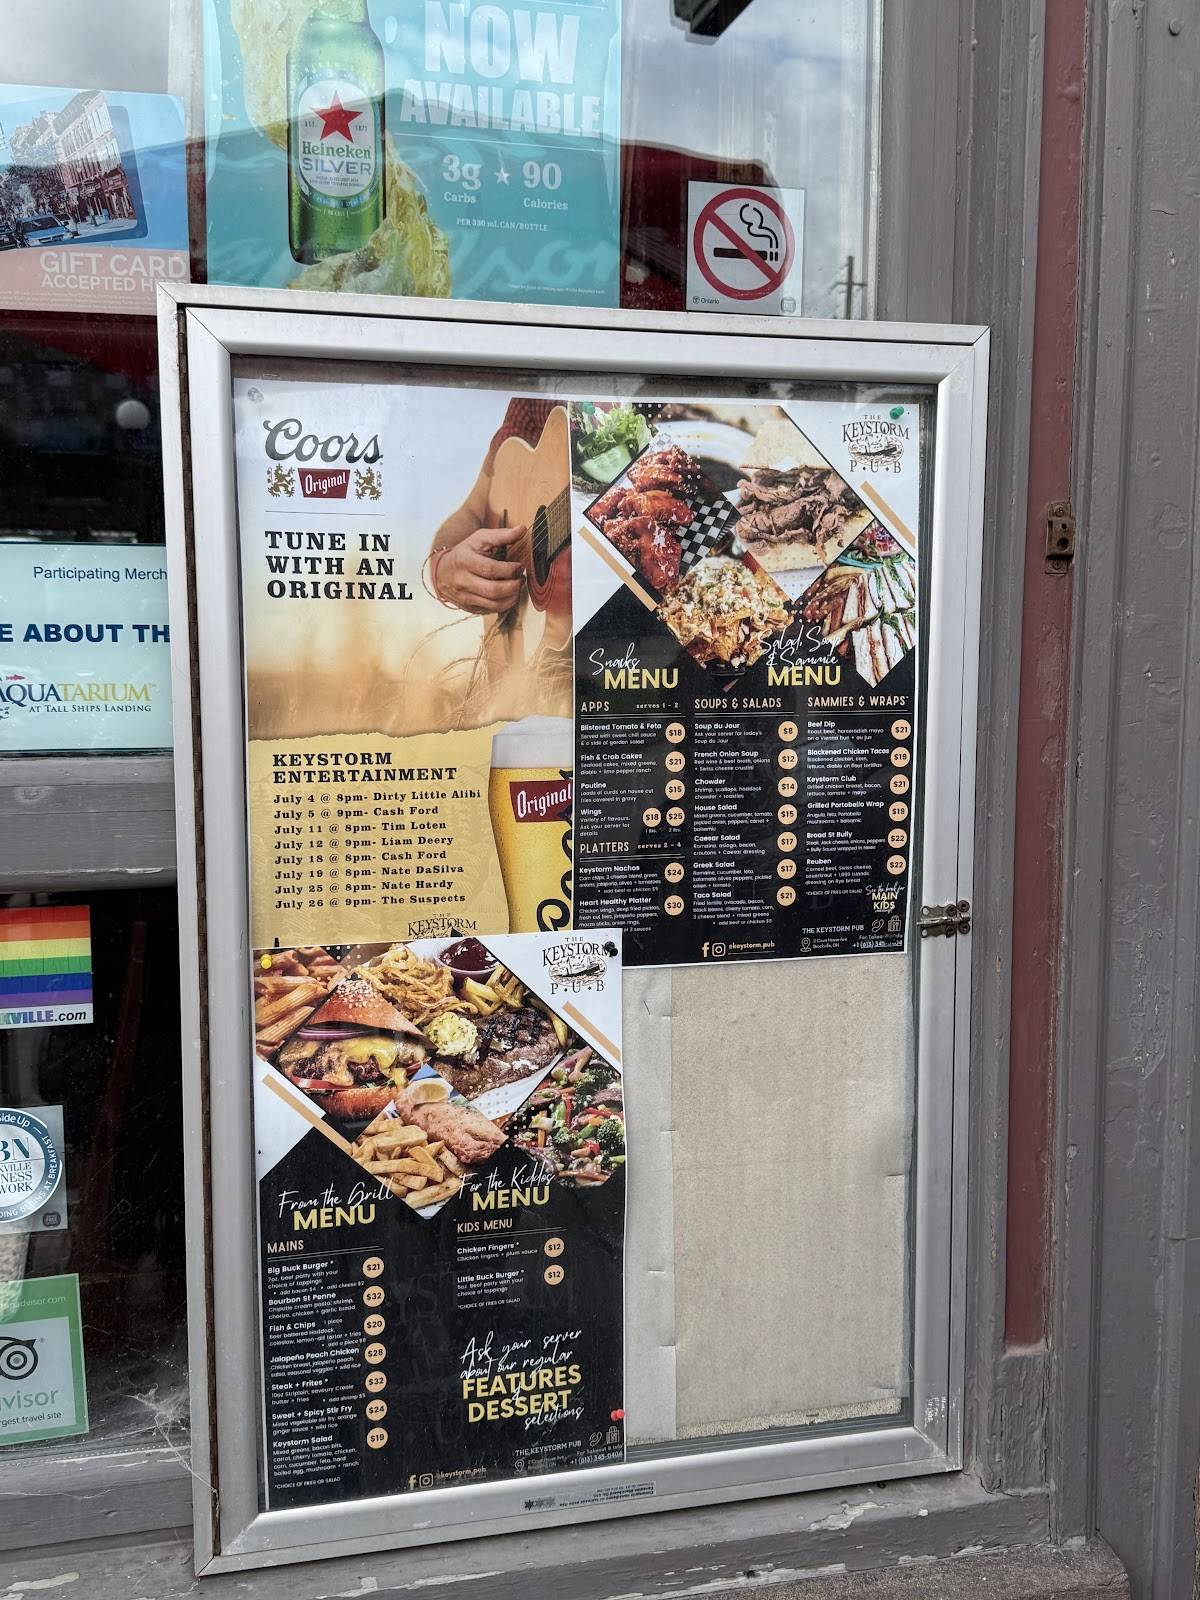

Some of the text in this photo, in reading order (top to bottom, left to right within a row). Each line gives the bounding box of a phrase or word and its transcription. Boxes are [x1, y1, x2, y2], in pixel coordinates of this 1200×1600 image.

[425, 0, 580, 84] NOW
[400, 80, 601, 138] AVAILABLE
[302, 141, 372, 159] Heineken
[302, 158, 372, 175] SILVER
[443, 154, 481, 191] 3g
[522, 162, 562, 190] 90
[444, 191, 476, 204] Carbs
[523, 197, 568, 211] Calories
[456, 218, 471, 227] PER
[472, 219, 486, 227] 330
[499, 222, 548, 231] CAN/BOTTLE
[40, 252, 186, 277] GIFT CARD
[41, 273, 138, 291] ACCEPTED
[842, 421, 910, 442] KEYSTORM
[263, 418, 383, 464] Coors
[305, 472, 346, 494] Original
[265, 531, 390, 551] TUNE IN
[266, 556, 394, 575] WITH AN
[33, 567, 167, 582] Participating Merch
[267, 580, 413, 600] ORIGINAL
[23, 624, 123, 642] ABOUT
[132, 625, 170, 642] TH
[589, 643, 641, 676] Snacks
[605, 669, 679, 690] MENU
[768, 665, 841, 686] MENU
[581, 702, 609, 712] APPS
[694, 698, 781, 709] SOUPS & SALADS
[807, 697, 854, 707] SAMMIES
[859, 696, 864, 707] &
[272, 753, 392, 766] KEYSTORM
[273, 768, 457, 784] ENTERTAINMENT
[273, 790, 481, 804] July 4 @ 8pm- Dirty Little Alibi
[517, 783, 571, 818] Original
[274, 806, 438, 820] July 5 @ 9pm- Cash Ford
[274, 825, 303, 835] July
[329, 824, 339, 833] @
[345, 824, 376, 833] 8pm-
[382, 823, 405, 831] Tim
[411, 821, 446, 830] Loten
[275, 840, 303, 850] July
[329, 839, 339, 848] @
[345, 839, 376, 848] 9pm-
[382, 837, 412, 846] Liam
[418, 836, 453, 846] Deery
[580, 842, 629, 853] PLATTERS
[275, 851, 447, 865] July 18 @ 8pm- Cash Ford
[275, 865, 464, 880] July 19 @ 8pm- Nate DaSilva
[580, 866, 612, 874] Keystorm
[275, 885, 303, 895] July
[329, 883, 339, 893] @
[345, 883, 376, 893] 8pm-
[382, 881, 411, 890] Nate
[416, 880, 453, 890] Hardy
[275, 900, 303, 909] July
[329, 898, 339, 907] @
[345, 897, 376, 907] 9pm-
[382, 896, 404, 904] The
[410, 894, 465, 905] Suspects
[408, 918, 478, 936] KEYSTORM
[17, 1117, 30, 1127] Up
[42, 1135, 58, 1178] BREAKFAST
[278, 1176, 394, 1218] From the Grill
[472, 1186, 550, 1212] MENU
[294, 1204, 376, 1231] MENU
[457, 1218, 513, 1234] KIDS MENU
[268, 1240, 304, 1254] MAINS
[457, 1243, 514, 1254] Chicken Fingers
[269, 1298, 301, 1306] Bourbon
[313, 1293, 336, 1301] Penne
[294, 1322, 316, 1330] Chips
[460, 1329, 582, 1364] Ask server
[463, 1364, 582, 1400] FEATURES
[468, 1389, 572, 1423] DESSERT
[22, 1413, 45, 1423] travel
[525, 1400, 585, 1430] selections
